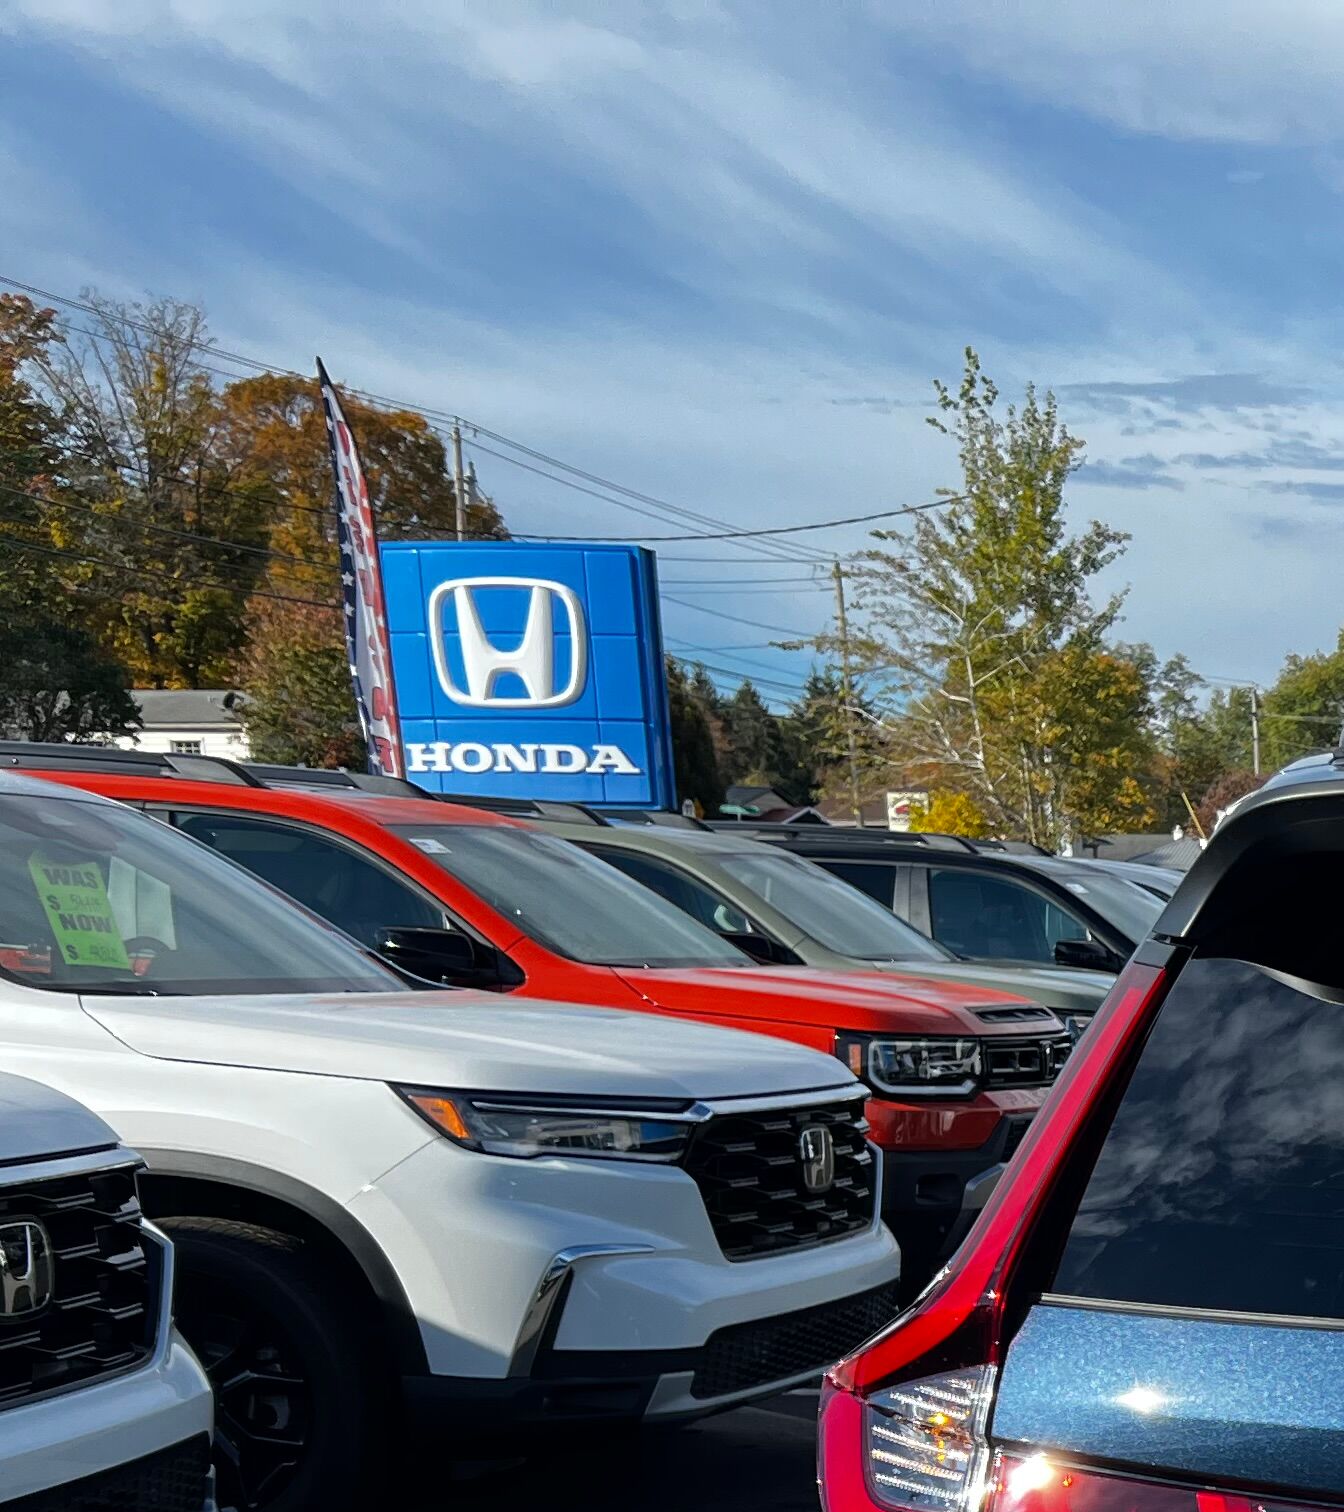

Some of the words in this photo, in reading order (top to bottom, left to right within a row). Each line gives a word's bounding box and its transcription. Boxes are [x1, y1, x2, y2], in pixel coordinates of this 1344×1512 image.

[405, 741, 641, 774] HONDA
[42, 868, 98, 889] WAS
[58, 913, 112, 933] NOW
